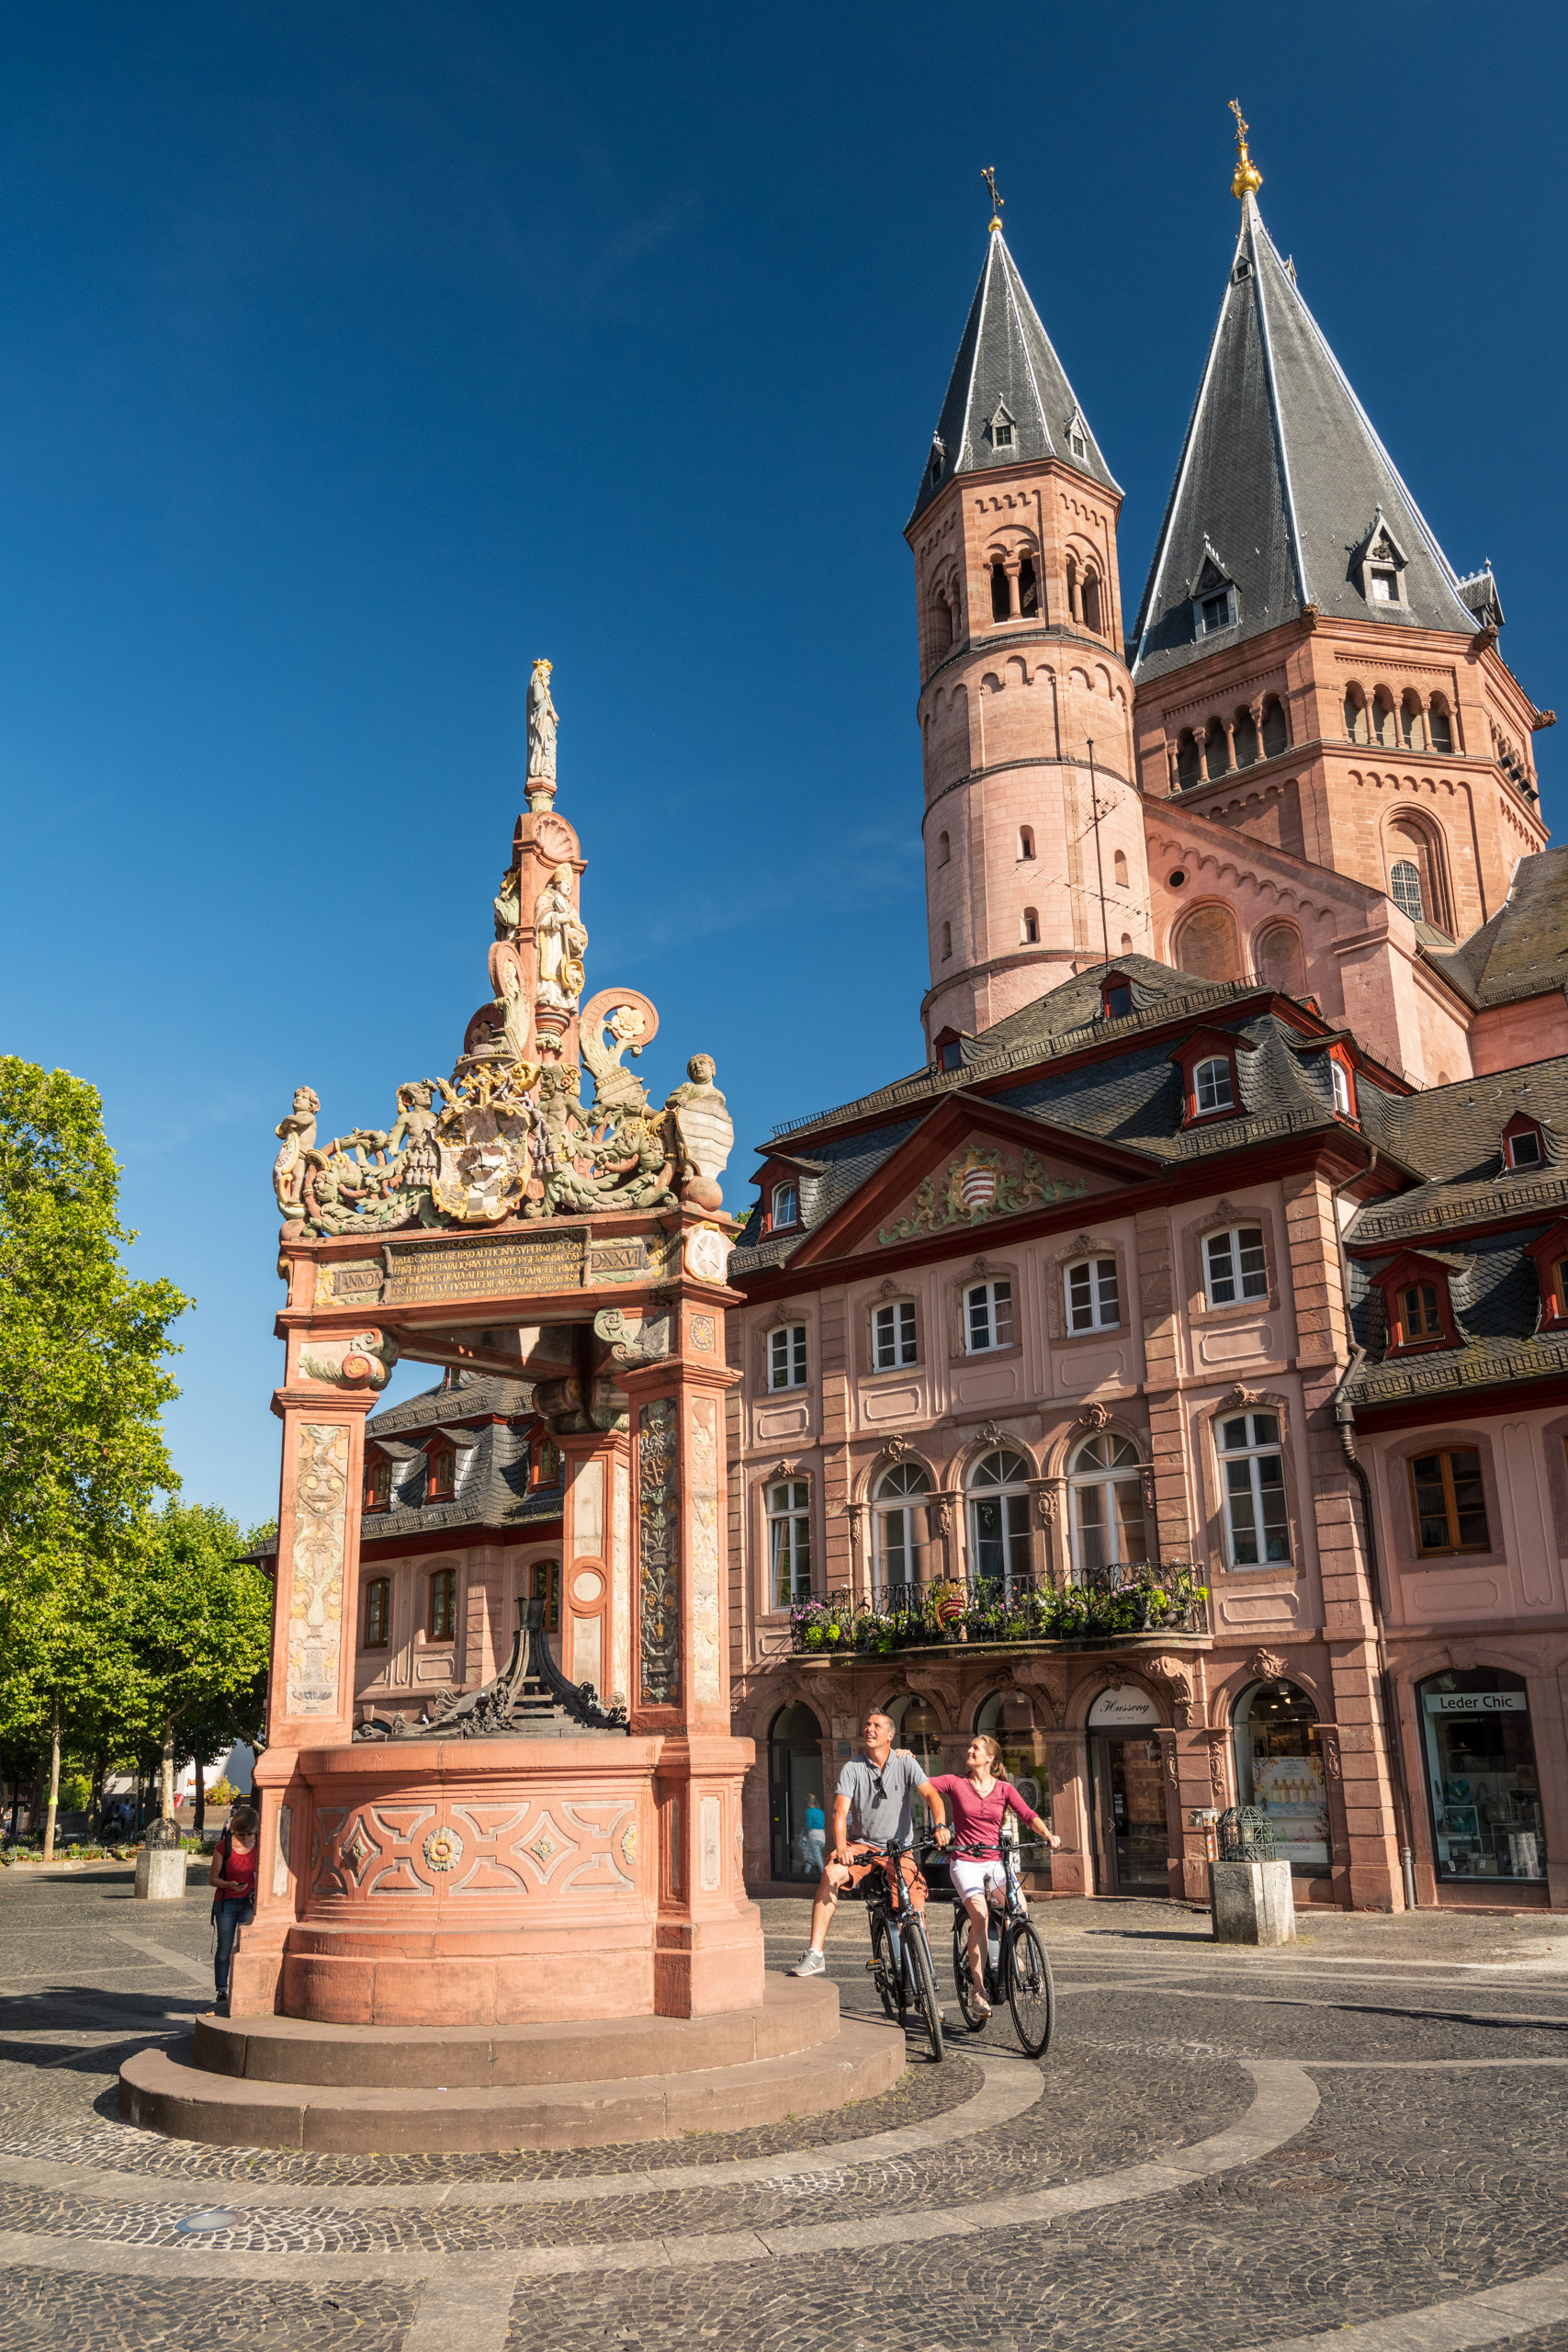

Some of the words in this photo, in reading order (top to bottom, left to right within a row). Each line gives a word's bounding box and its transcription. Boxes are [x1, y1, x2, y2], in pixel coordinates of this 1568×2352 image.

[1100, 1700, 1150, 1714] Hussong
[1440, 1697, 1478, 1709] Leder
[1483, 1695, 1513, 1708] Chic
